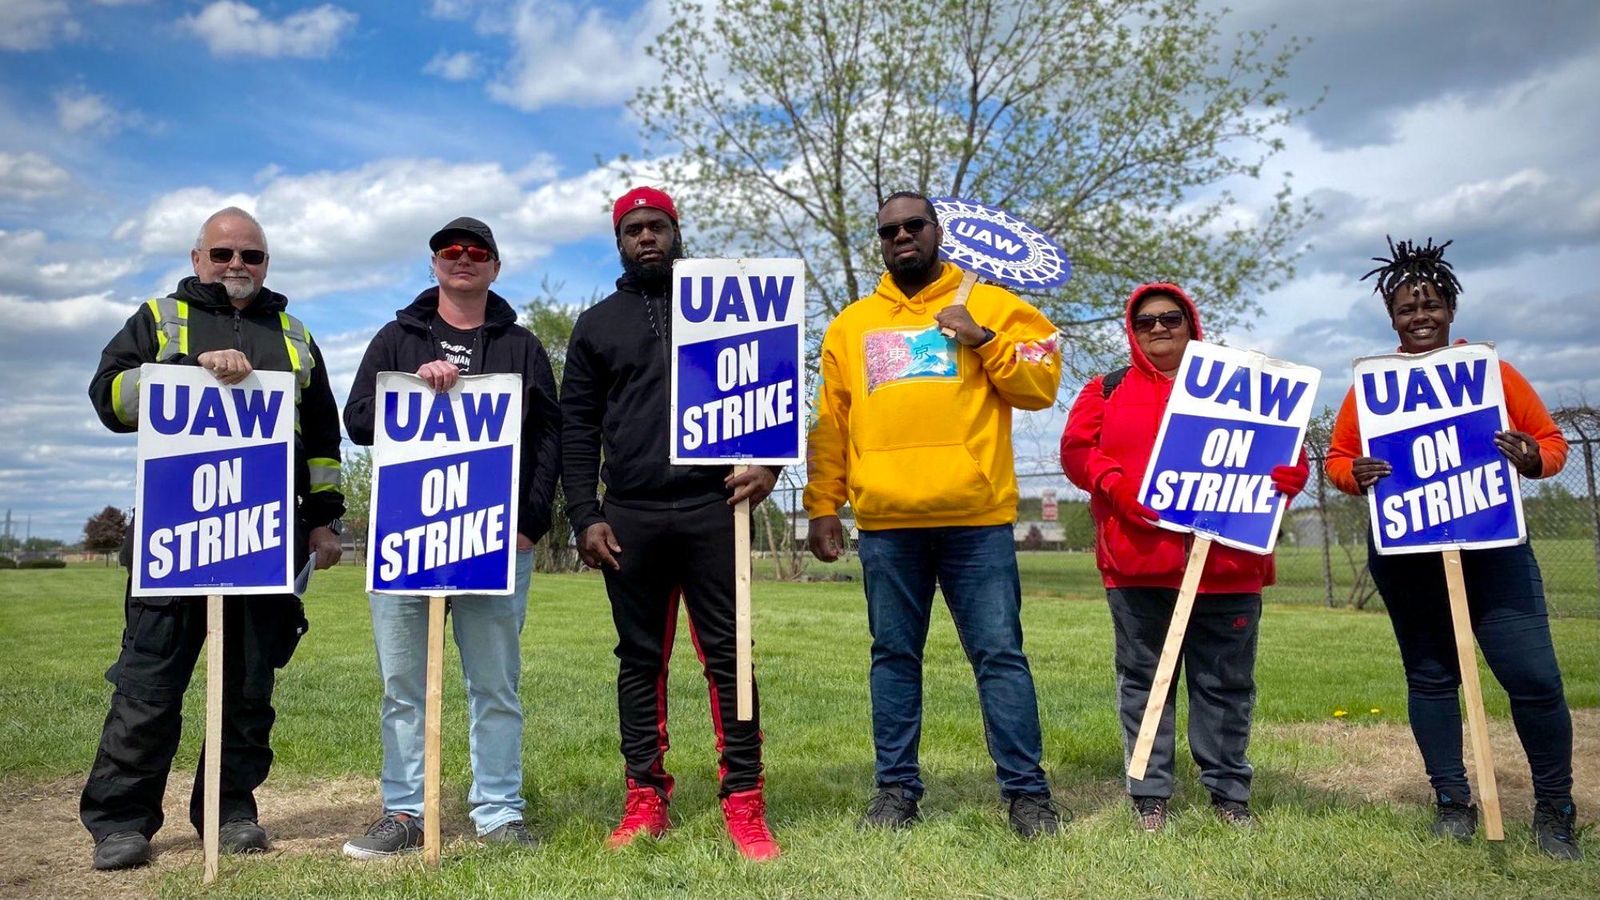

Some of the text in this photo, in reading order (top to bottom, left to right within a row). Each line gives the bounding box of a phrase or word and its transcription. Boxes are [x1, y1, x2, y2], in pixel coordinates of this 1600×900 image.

[956, 221, 1022, 255] UAW
[680, 276, 794, 323] UAW
[718, 340, 759, 391] ON
[888, 343, 932, 361] 東京
[149, 383, 284, 439] UAW
[1185, 356, 1308, 421] UAW
[1362, 359, 1487, 416] UAW
[384, 391, 511, 442] UAW
[683, 380, 793, 451] STRIKE
[1201, 428, 1256, 468] ON
[1413, 425, 1462, 479] ON
[192, 458, 242, 513] ON
[421, 461, 469, 517] ON
[1150, 470, 1277, 513] STRIKE
[1383, 460, 1508, 539] STRIKE
[148, 500, 281, 579] STRIKE
[381, 503, 505, 582] STRIKE
